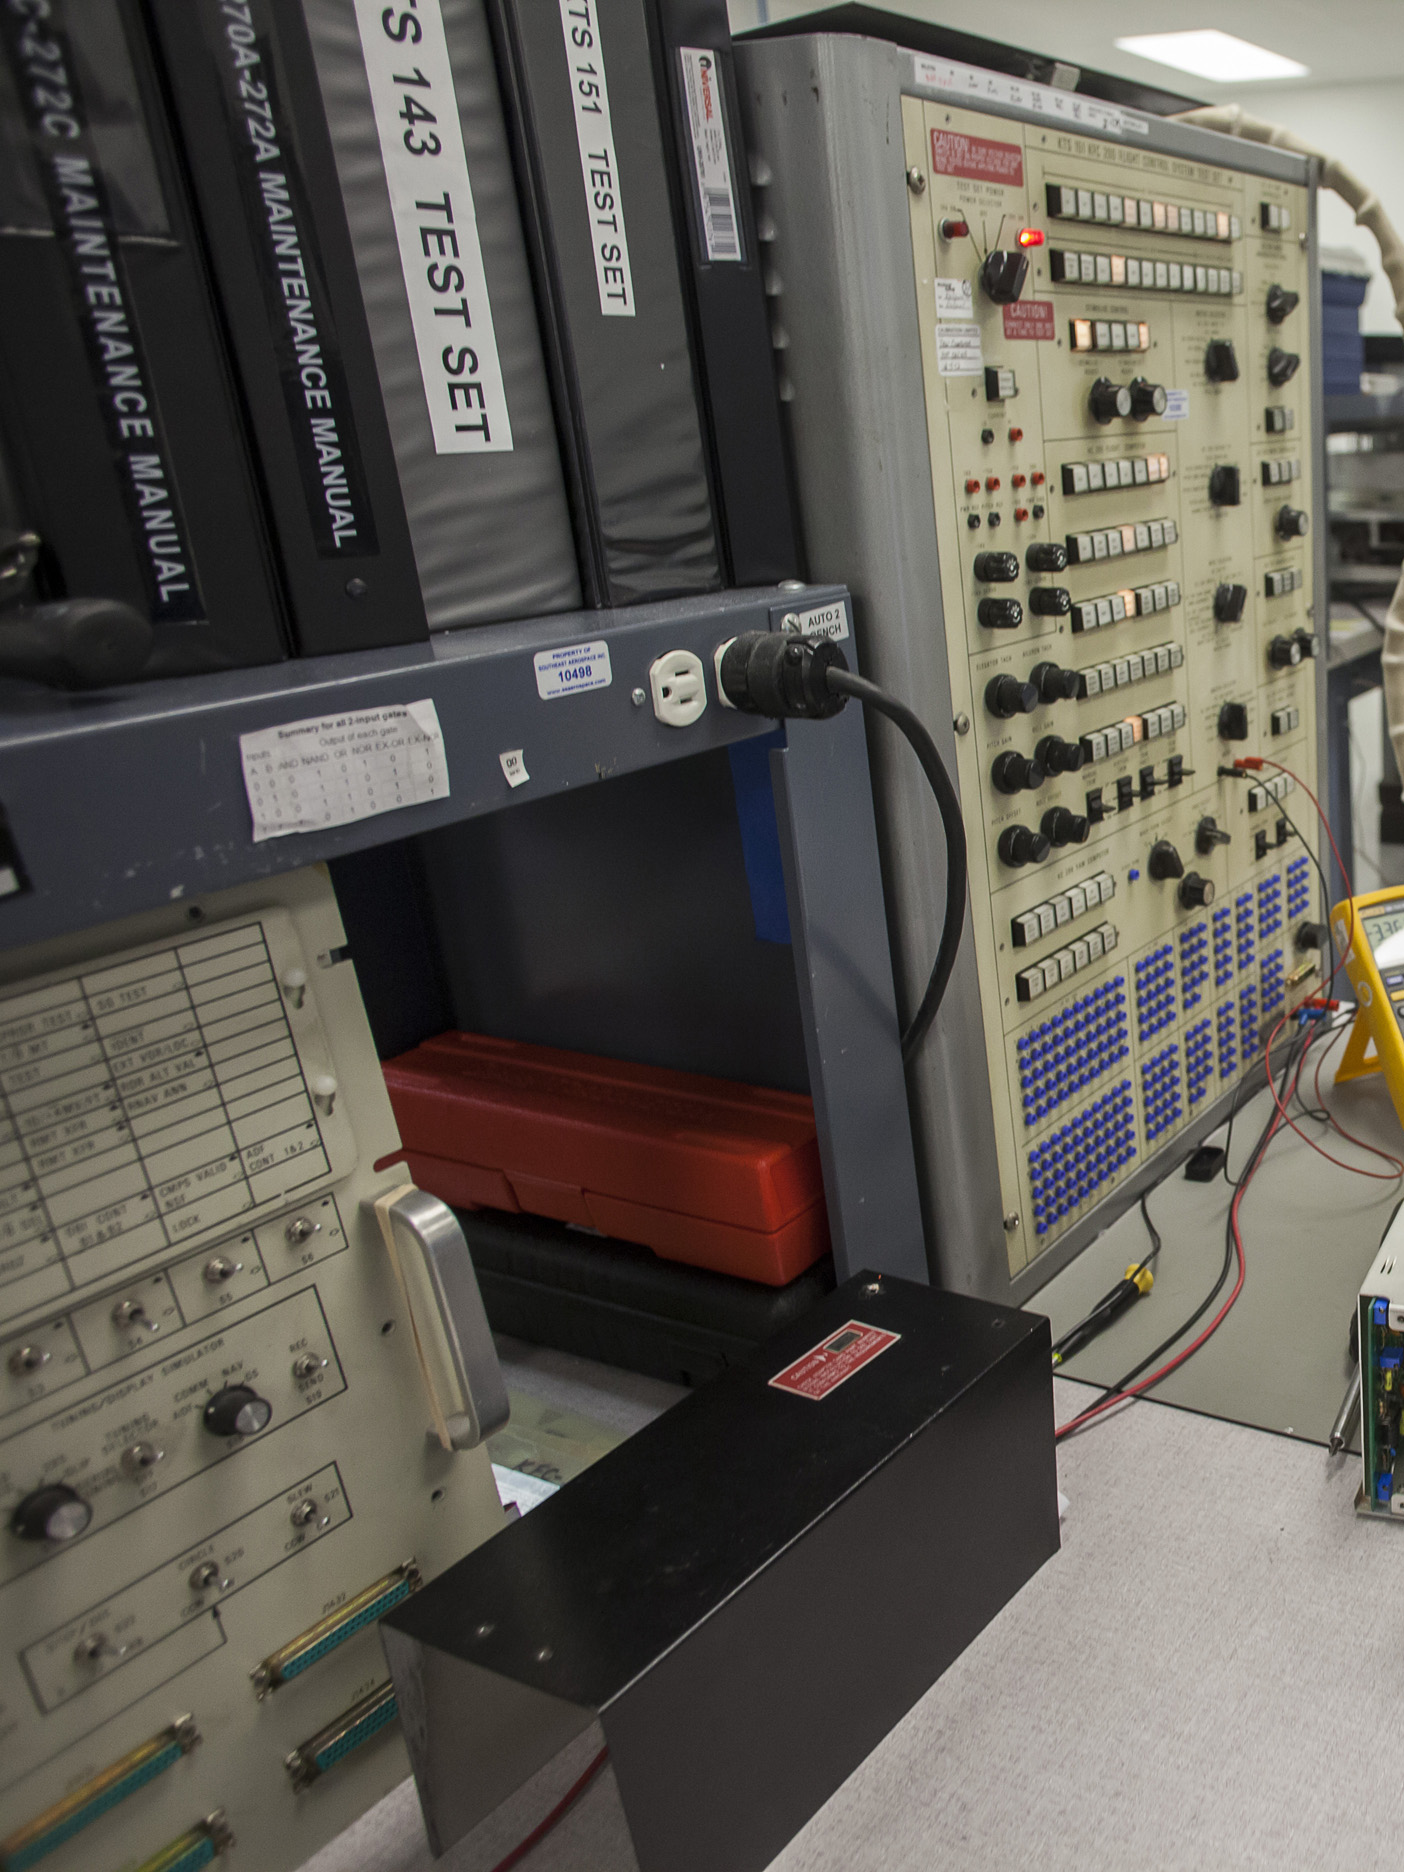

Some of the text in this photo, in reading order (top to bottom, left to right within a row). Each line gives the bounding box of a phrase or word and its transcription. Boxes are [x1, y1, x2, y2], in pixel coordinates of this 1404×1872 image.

[568, 0, 626, 306] TS 151 TEST SET
[381, 0, 491, 443] S 143 TEST SET
[222, 0, 360, 549] 70A-272A MAINTENANCE MANUAL
[54, 154, 154, 438] MAINTENANCE
[128, 455, 190, 602] MANUAL
[808, 608, 840, 628] AUTO 2
[552, 648, 582, 660] PROPERTY
[558, 665, 593, 683] 10498
[278, 726, 319, 739] Summary
[321, 721, 334, 731] for
[336, 718, 347, 728] all
[383, 710, 407, 721] gates
[319, 725, 398, 748] Output of each gate
[352, 743, 373, 756] NOR
